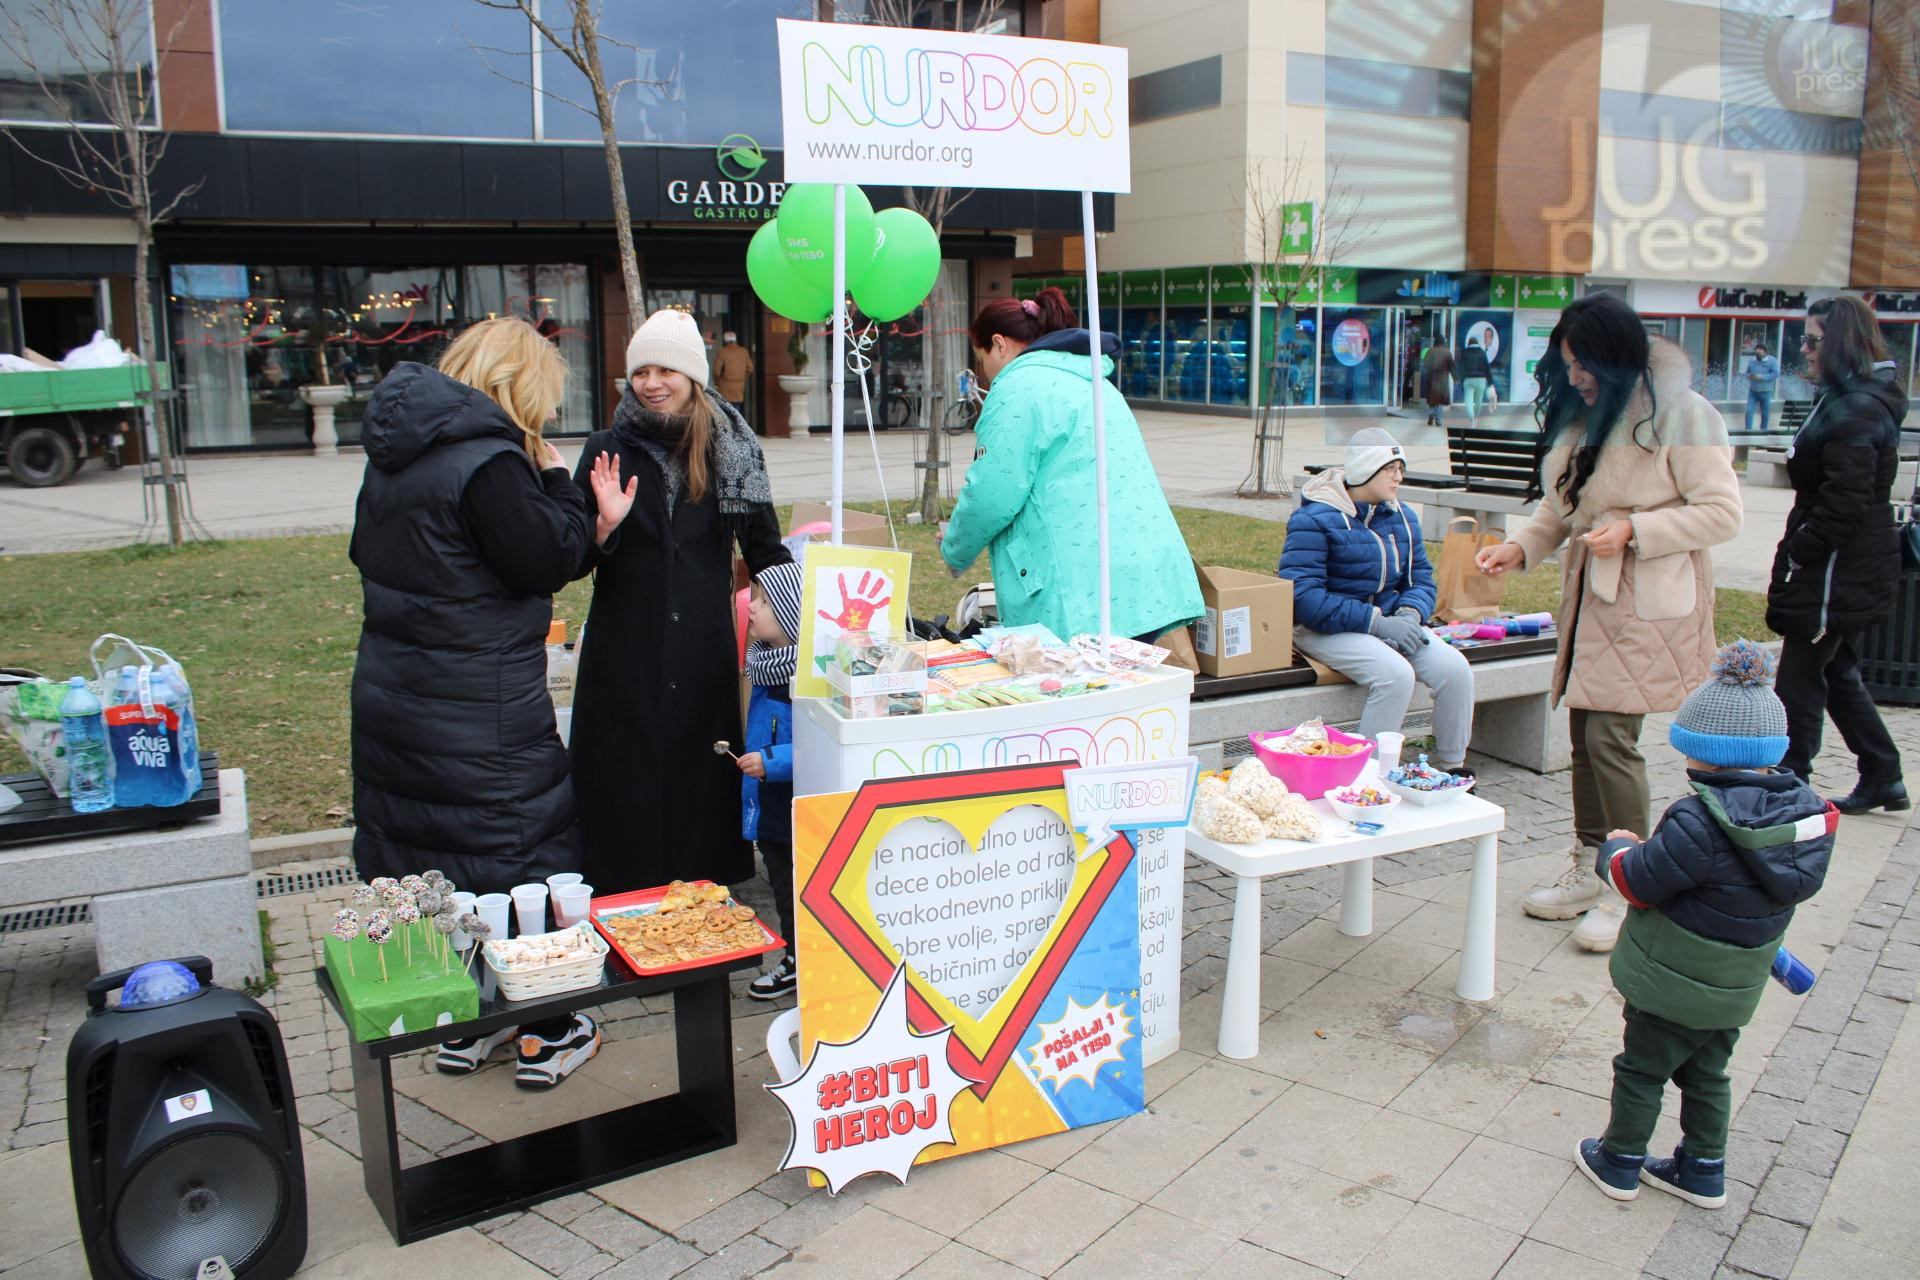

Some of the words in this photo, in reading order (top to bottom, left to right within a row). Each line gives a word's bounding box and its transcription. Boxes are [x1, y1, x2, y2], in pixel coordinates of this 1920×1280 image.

[803, 41, 1114, 138] NURDOR
[807, 139, 973, 168] www.nurdor.org
[693, 207, 759, 219] GASTRO
[1775, 289, 1808, 310] Bank
[132, 751, 167, 768] viva
[1077, 777, 1183, 813] NURDOR
[1023, 818, 1070, 844] udru
[1148, 827, 1166, 845] se
[874, 874, 929, 897] dece
[935, 860, 1011, 889] obolele
[1016, 850, 1041, 876] od
[874, 892, 1015, 928] svakodnevno
[946, 924, 998, 951] volje,
[1146, 933, 1165, 958] od
[1042, 1017, 1105, 1059] POŠALJI
[1105, 1011, 1116, 1027] 1
[1055, 1050, 1079, 1072] NA
[1081, 1032, 1113, 1058] 1150
[817, 1054, 930, 1110] #BITI
[813, 1093, 938, 1154] HEROJ
